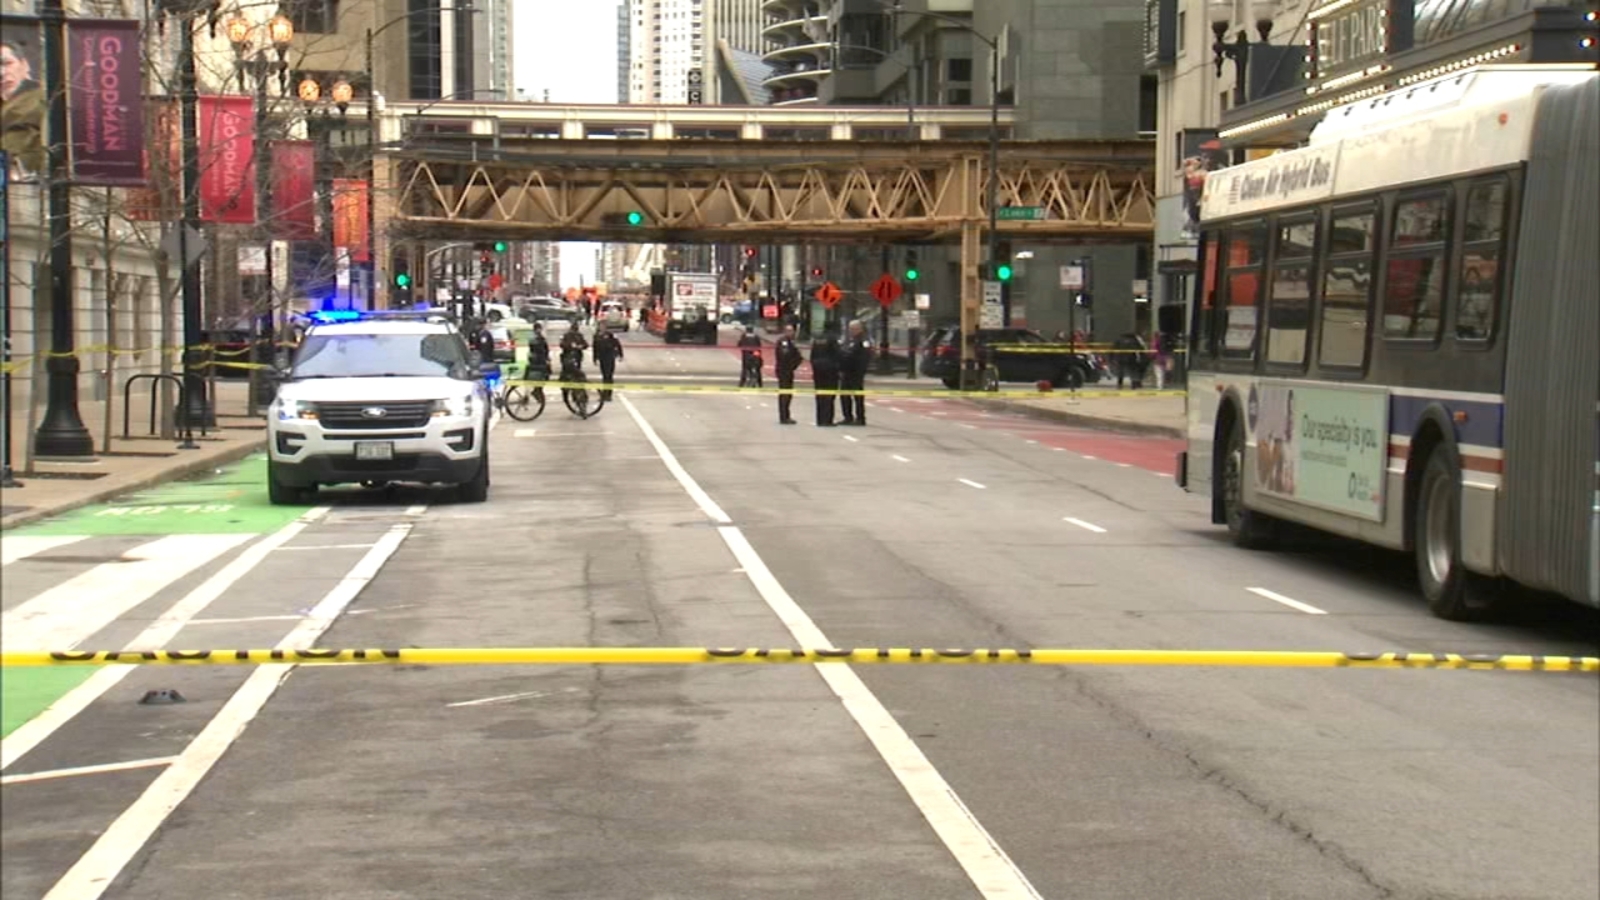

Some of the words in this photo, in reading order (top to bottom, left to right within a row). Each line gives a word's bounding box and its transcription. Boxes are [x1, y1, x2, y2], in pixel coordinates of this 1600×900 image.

[100, 36, 121, 150] GOODMAN
[1240, 172, 1266, 200] Clean
[1265, 165, 1282, 196] Air
[1279, 157, 1313, 199] Hybrid
[1309, 156, 1331, 188] Bus
[1302, 413, 1316, 438] Our
[1317, 415, 1351, 451] specialty
